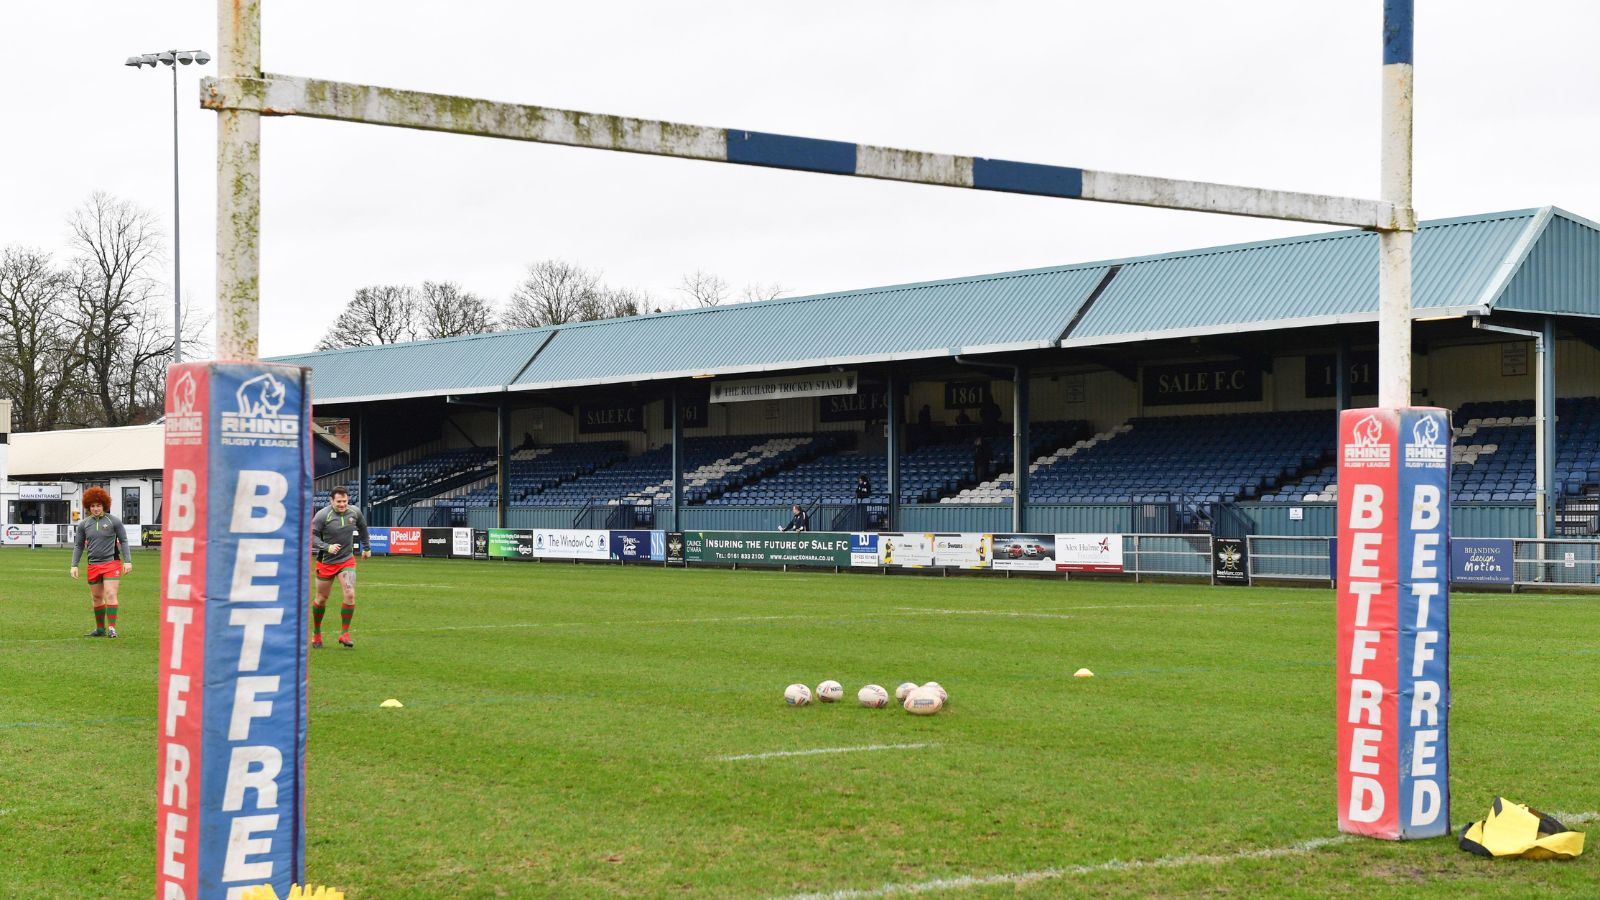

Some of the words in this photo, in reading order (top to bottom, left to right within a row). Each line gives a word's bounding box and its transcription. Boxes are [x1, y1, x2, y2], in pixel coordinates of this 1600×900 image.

[1158, 371, 1209, 393] SALE
[1214, 369, 1246, 391] F.C
[1323, 363, 1370, 385] 161
[724, 387, 739, 397] THE
[740, 384, 776, 396] RICHARD
[778, 382, 813, 394] TRICKEY
[815, 379, 843, 391] STAND
[951, 387, 984, 405] 1861
[831, 395, 865, 412] SALE
[166, 417, 202, 432] RHINO
[587, 409, 616, 425] SALE
[221, 418, 299, 434] RHINO
[221, 438, 256, 447] RUGBY
[259, 438, 299, 448] LEAGUE
[1344, 448, 1391, 458] RHINO
[1405, 448, 1447, 458] RHINO
[396, 531, 408, 541] Peel
[409, 531, 421, 541] L&P
[548, 534, 560, 547] The
[560, 535, 584, 547] Window
[585, 536, 594, 548] Co
[650, 532, 665, 556] SIS
[705, 538, 743, 549] INSURING
[745, 541, 761, 549] THE
[764, 541, 797, 549] FUTURE
[798, 541, 810, 550] OF
[811, 540, 833, 550] SALE
[836, 541, 848, 551] FC
[1064, 543, 1077, 551] Alex
[1469, 551, 1496, 563] design
[1464, 562, 1502, 572] Motion
[1348, 484, 1385, 823] BETFRED
[1410, 484, 1441, 827] BETFRED
[163, 469, 197, 900] BETFRE
[222, 470, 288, 900] BETFRE
